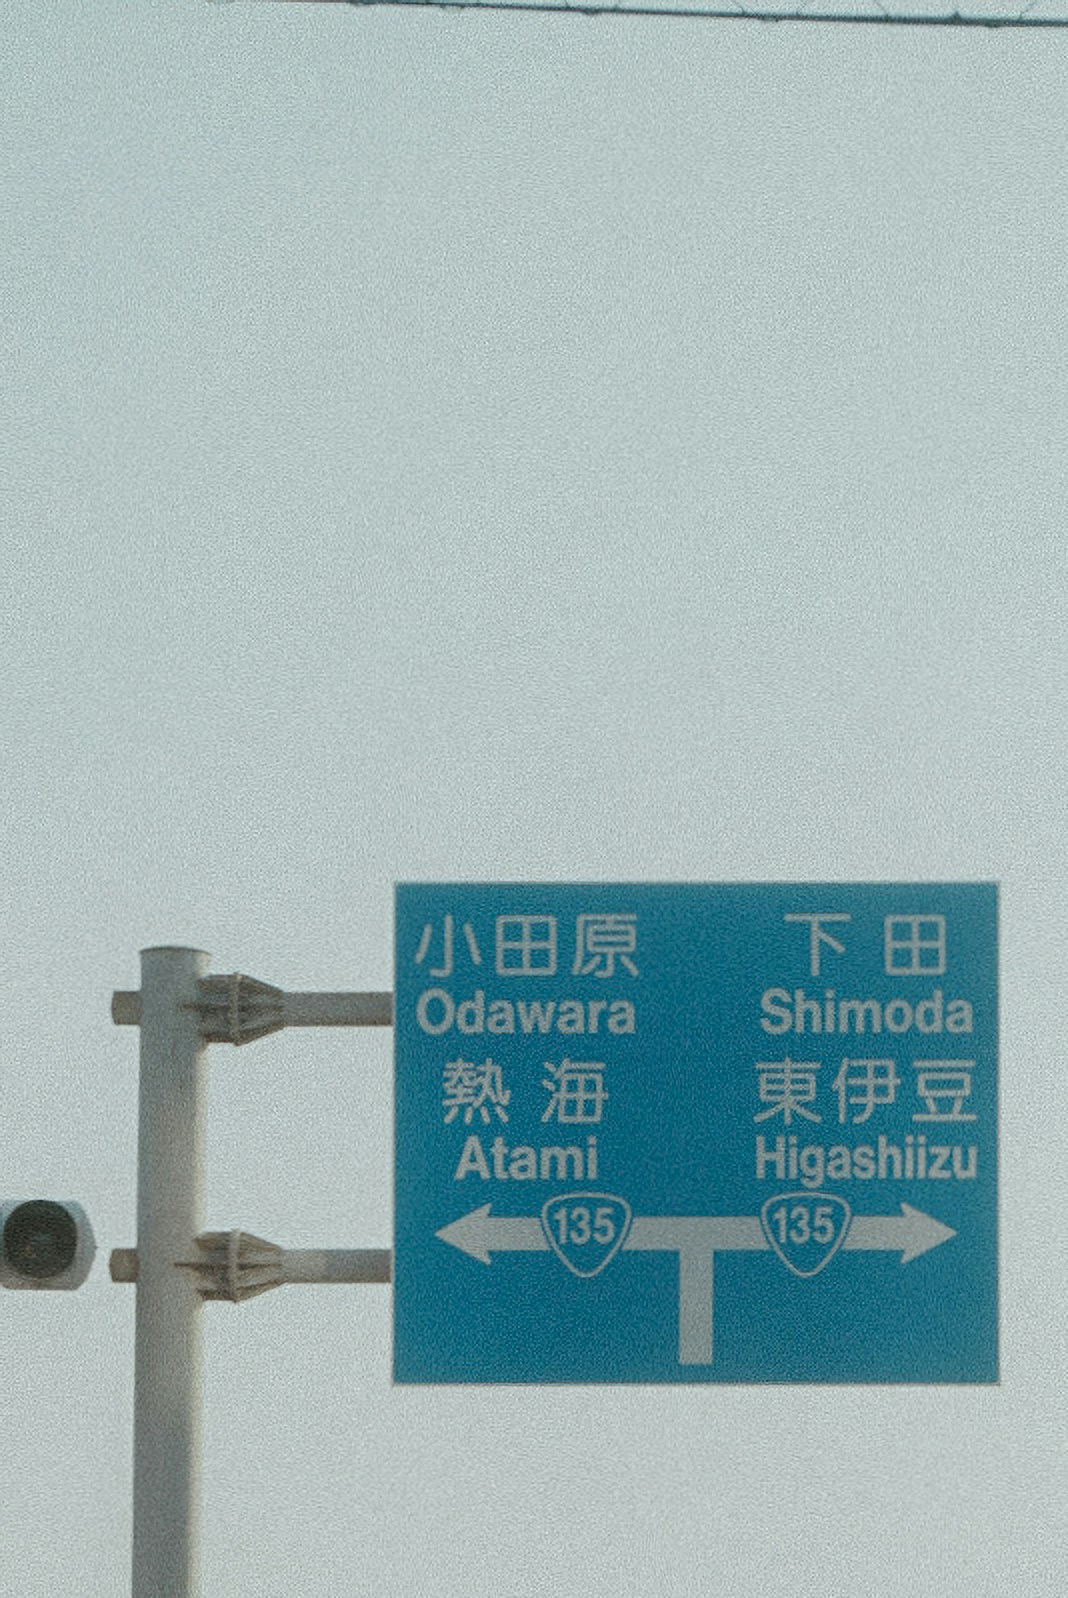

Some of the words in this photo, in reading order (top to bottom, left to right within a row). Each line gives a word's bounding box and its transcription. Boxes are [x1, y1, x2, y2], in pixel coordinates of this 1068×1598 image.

[414, 913, 639, 978] 小田原
[784, 913, 947, 977] 下田
[416, 987, 637, 1035] Odawara
[760, 986, 974, 1035] Shimoda
[441, 1057, 610, 1125] 熱海
[753, 1056, 978, 1125] 東伊豆
[454, 1135, 598, 1181] Atami
[755, 1135, 978, 1189] Higashiizu
[552, 1206, 616, 1246] 135
[772, 1206, 836, 1246] 135
